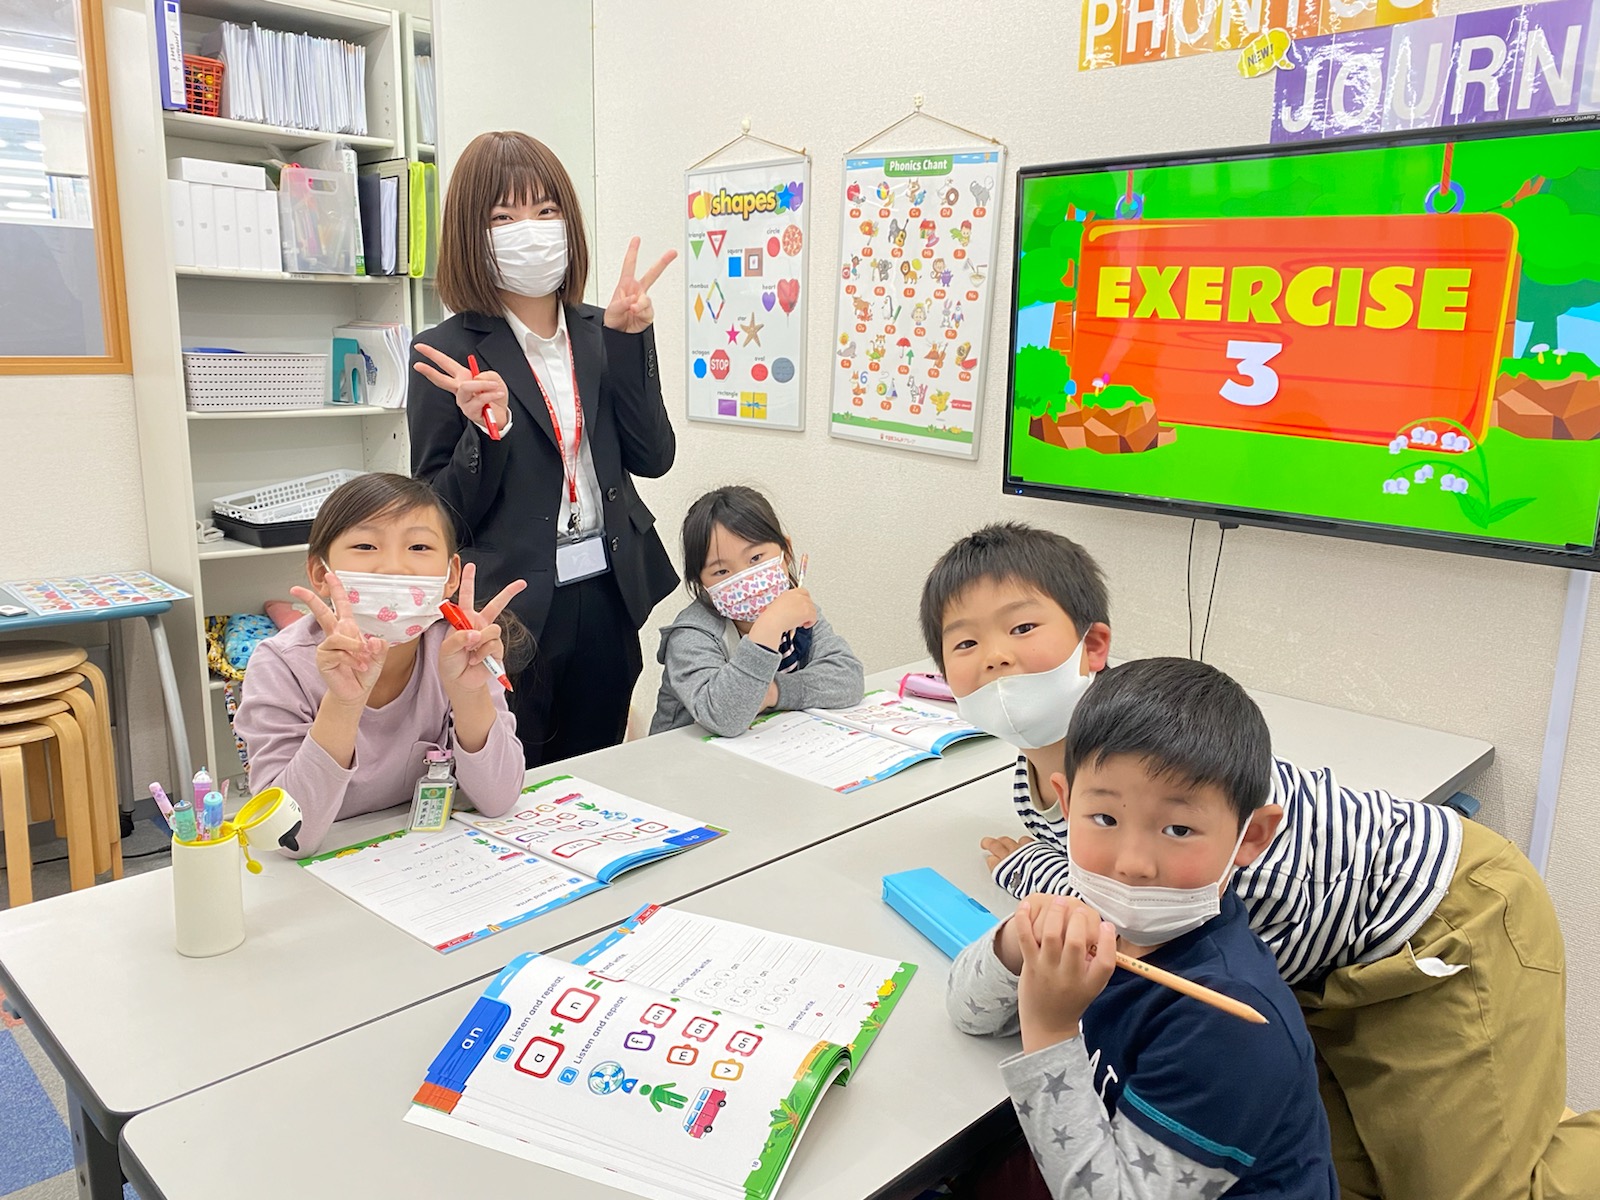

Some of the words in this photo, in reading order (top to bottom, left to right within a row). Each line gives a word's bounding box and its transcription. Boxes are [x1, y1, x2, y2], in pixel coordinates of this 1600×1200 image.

[1247, 43, 1275, 68] NEW!
[1281, 23, 1600, 133] JOURN
[889, 160, 922, 172] Phonics
[922, 159, 948, 171] Chant
[711, 188, 777, 221] shapes
[1095, 265, 1473, 332] EXERCISE
[710, 358, 729, 371] STOP
[860, 371, 869, 385] 6
[1218, 339, 1284, 407] 3
[509, 1017, 531, 1042] Listen
[529, 999, 543, 1016] and
[541, 975, 565, 1000] repeat.
[570, 1001, 582, 1010] n
[652, 1009, 665, 1020] an
[573, 1039, 595, 1064] Listen
[593, 1020, 607, 1037] and
[604, 996, 627, 1020] repeat.
[694, 1023, 707, 1034] an
[461, 1027, 483, 1050] an
[738, 1037, 750, 1049] an
[534, 1053, 545, 1063] a
[679, 1051, 688, 1061] m
